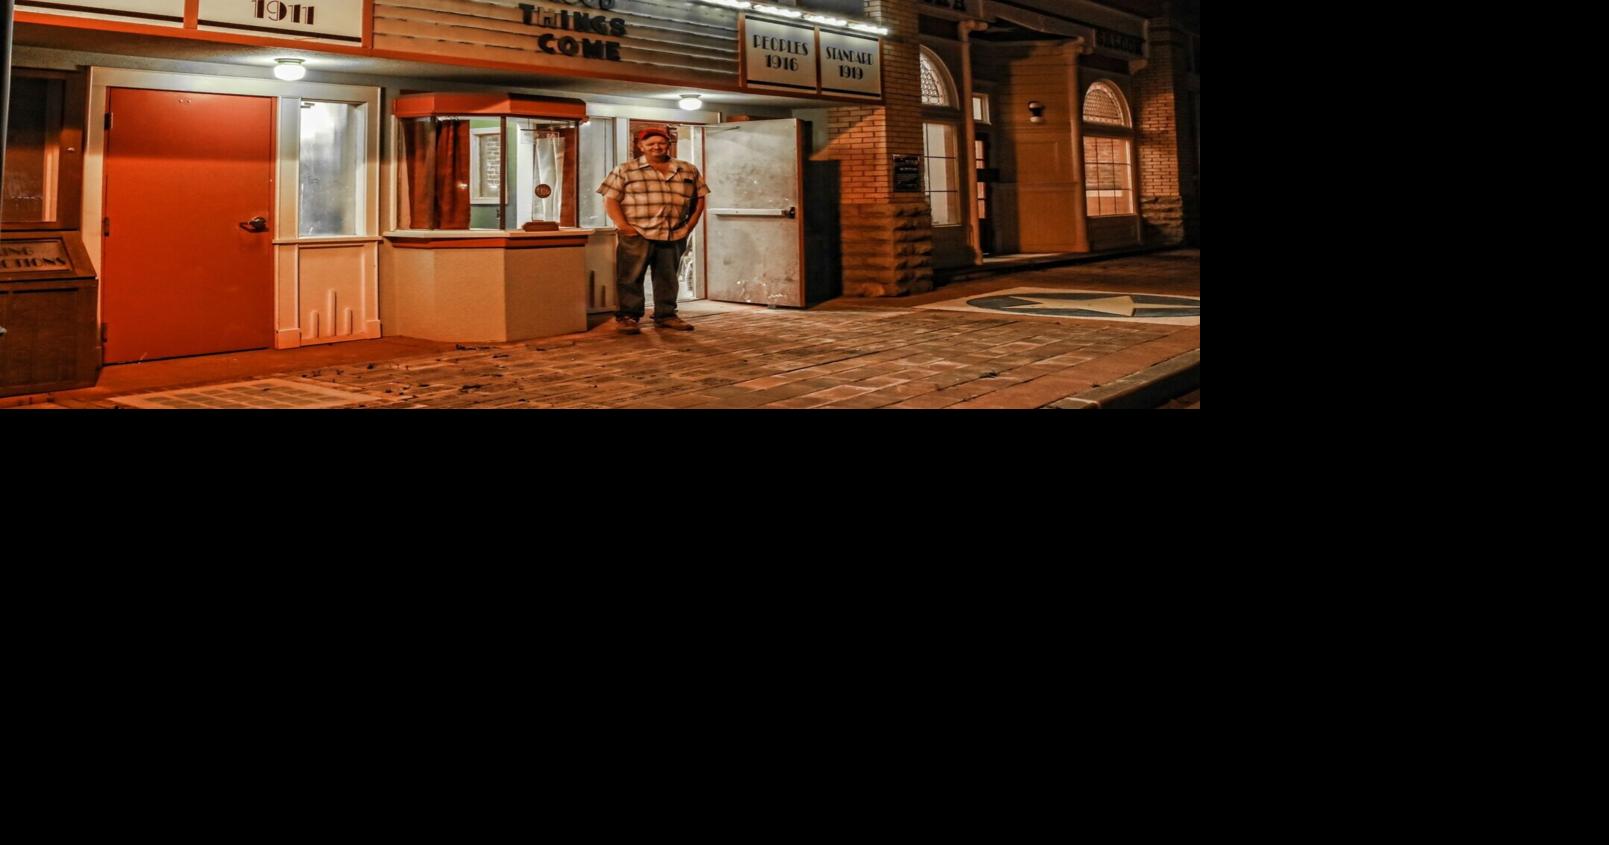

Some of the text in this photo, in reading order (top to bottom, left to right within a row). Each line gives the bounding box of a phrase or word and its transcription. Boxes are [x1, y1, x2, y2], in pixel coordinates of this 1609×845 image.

[251, 0, 314, 25] 1911
[518, 3, 627, 36] THINGS
[537, 33, 622, 62] COME
[753, 34, 809, 56] PEOPLES
[825, 46, 874, 66] STANDARD
[765, 54, 799, 71] 1916
[838, 65, 863, 80] 1919
